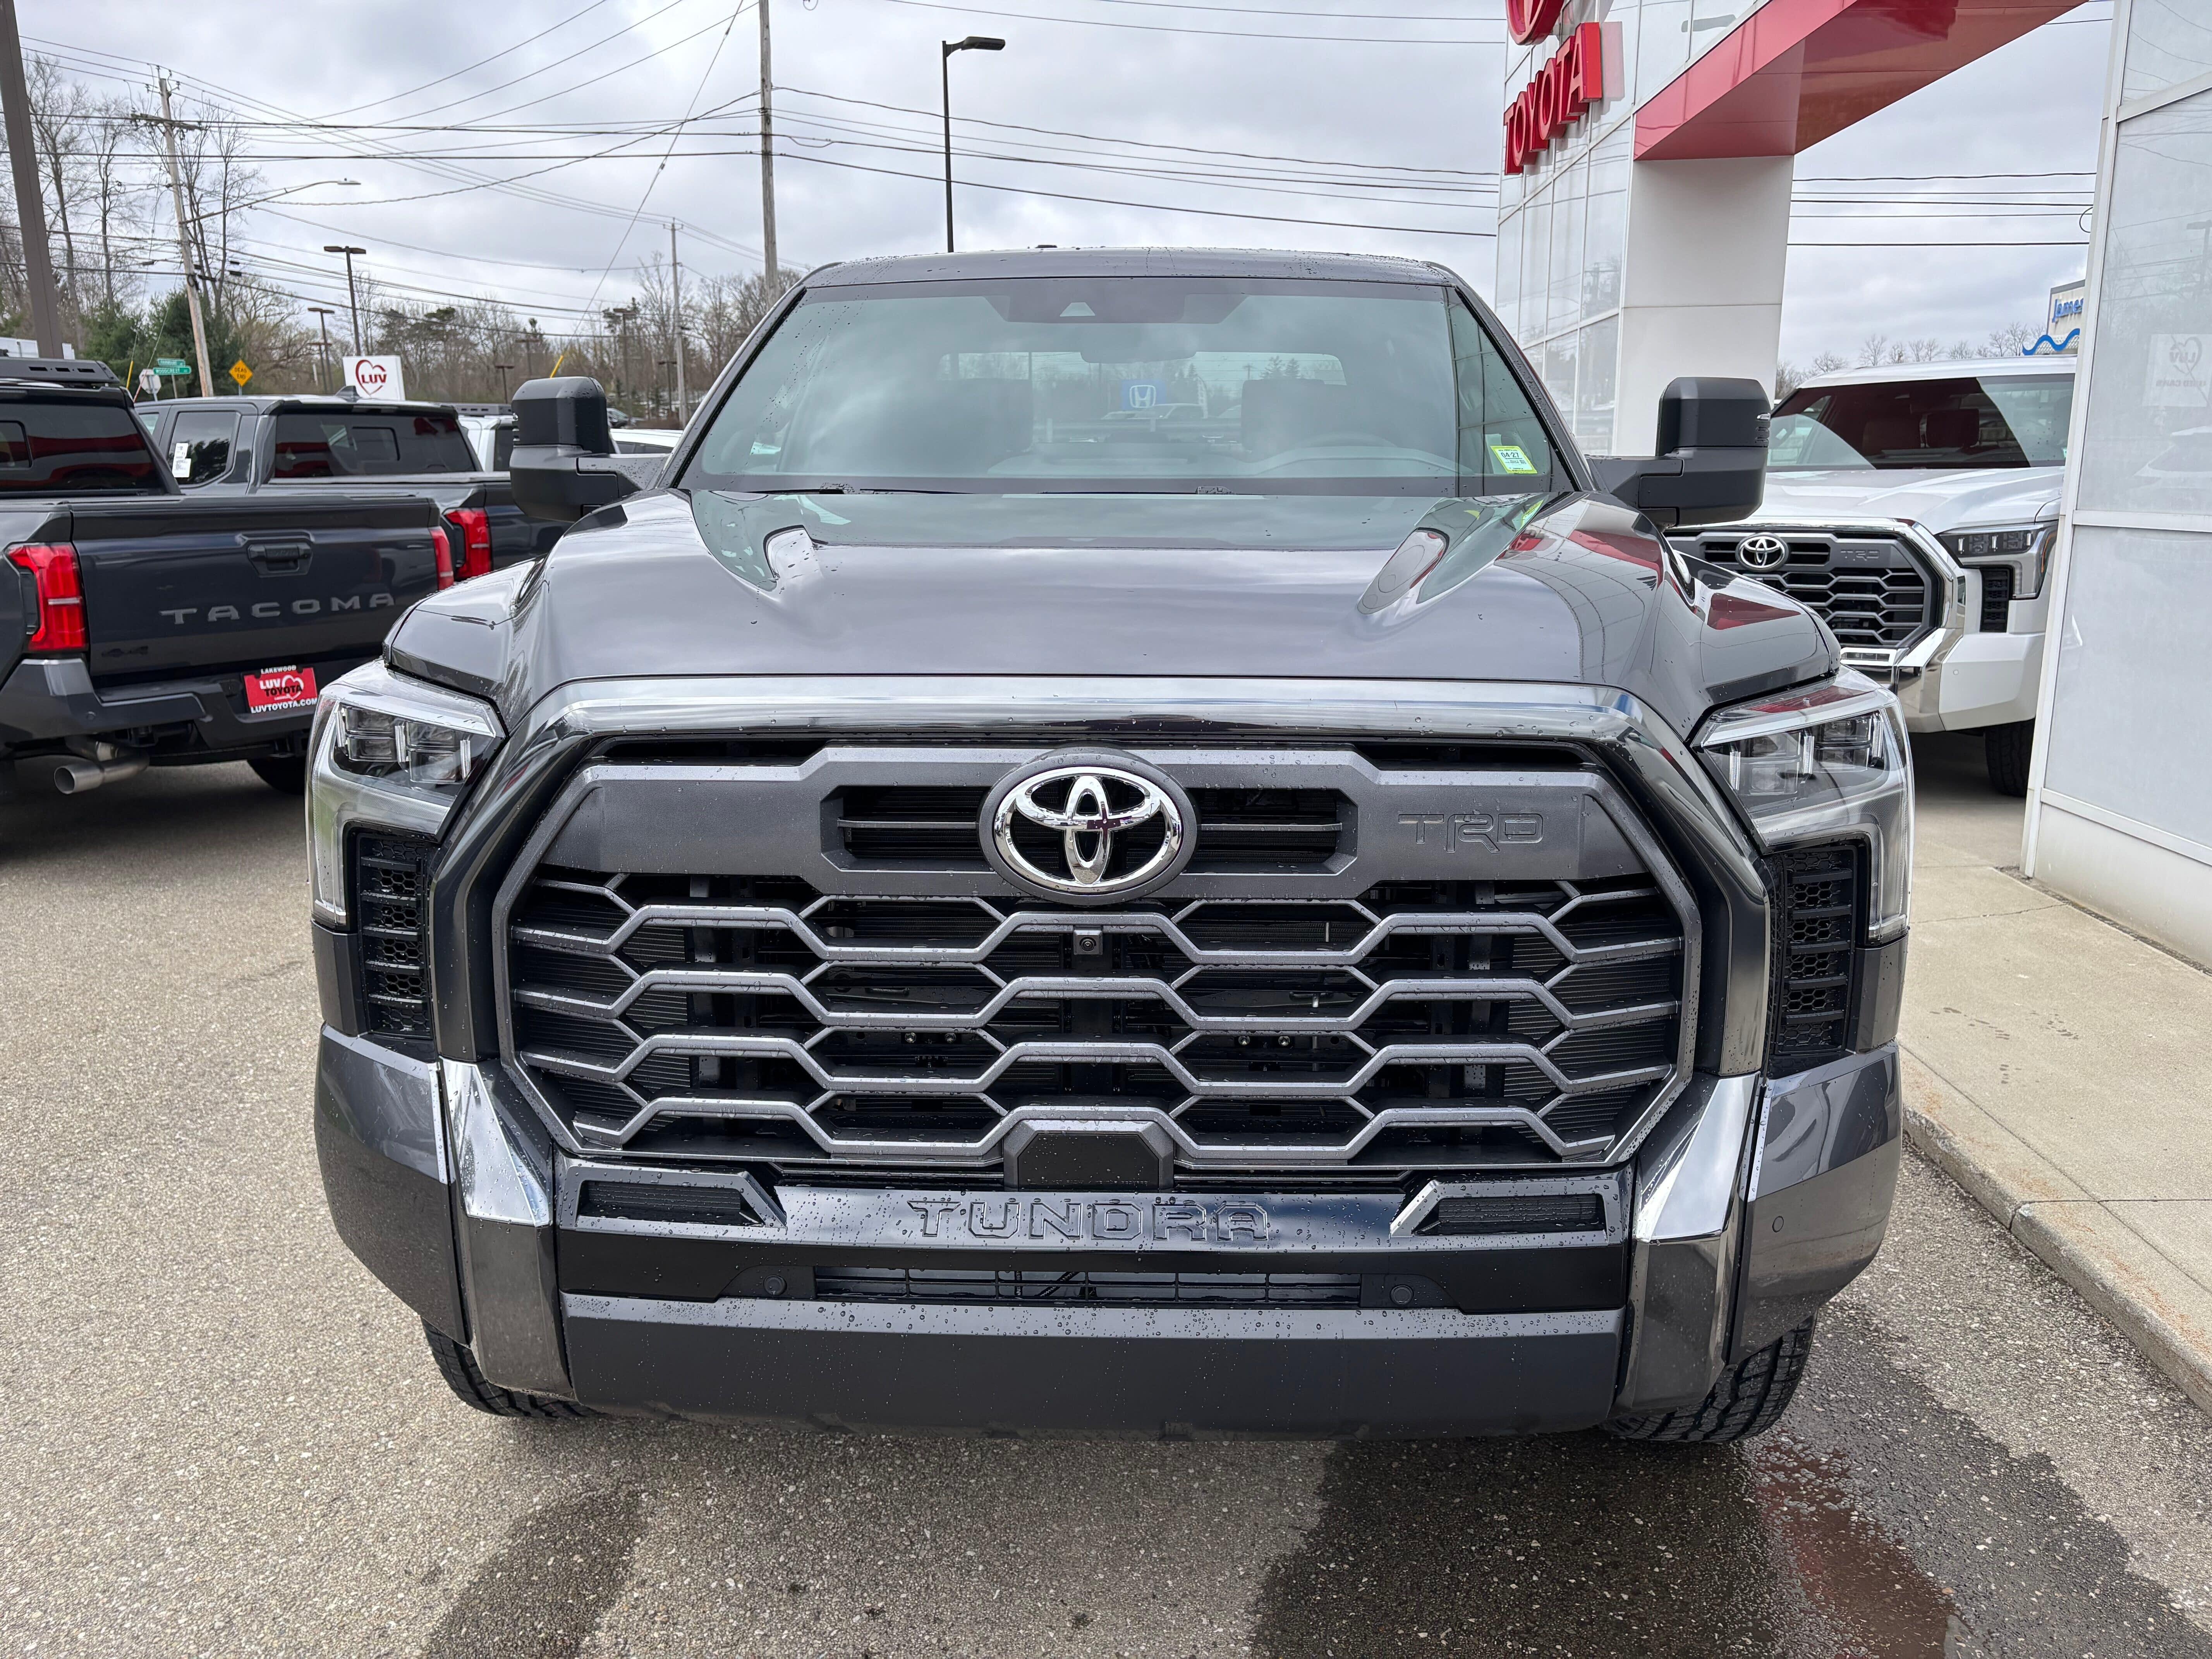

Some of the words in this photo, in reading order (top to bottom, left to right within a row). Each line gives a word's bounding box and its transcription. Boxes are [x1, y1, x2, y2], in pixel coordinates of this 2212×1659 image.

[1504, 22, 1602, 175] TOYOTA
[361, 374, 386, 384] LUV
[1840, 549, 1880, 561] TRD
[159, 592, 395, 625] TACOMA
[261, 665, 297, 675] LAKEWOOD
[259, 678, 280, 690] LUV
[264, 685, 302, 697] TOYOTA
[251, 697, 318, 714] LUVTOYOTA.COM
[1398, 813, 1544, 853] TRD
[906, 1199, 1268, 1241] TUNDRA
